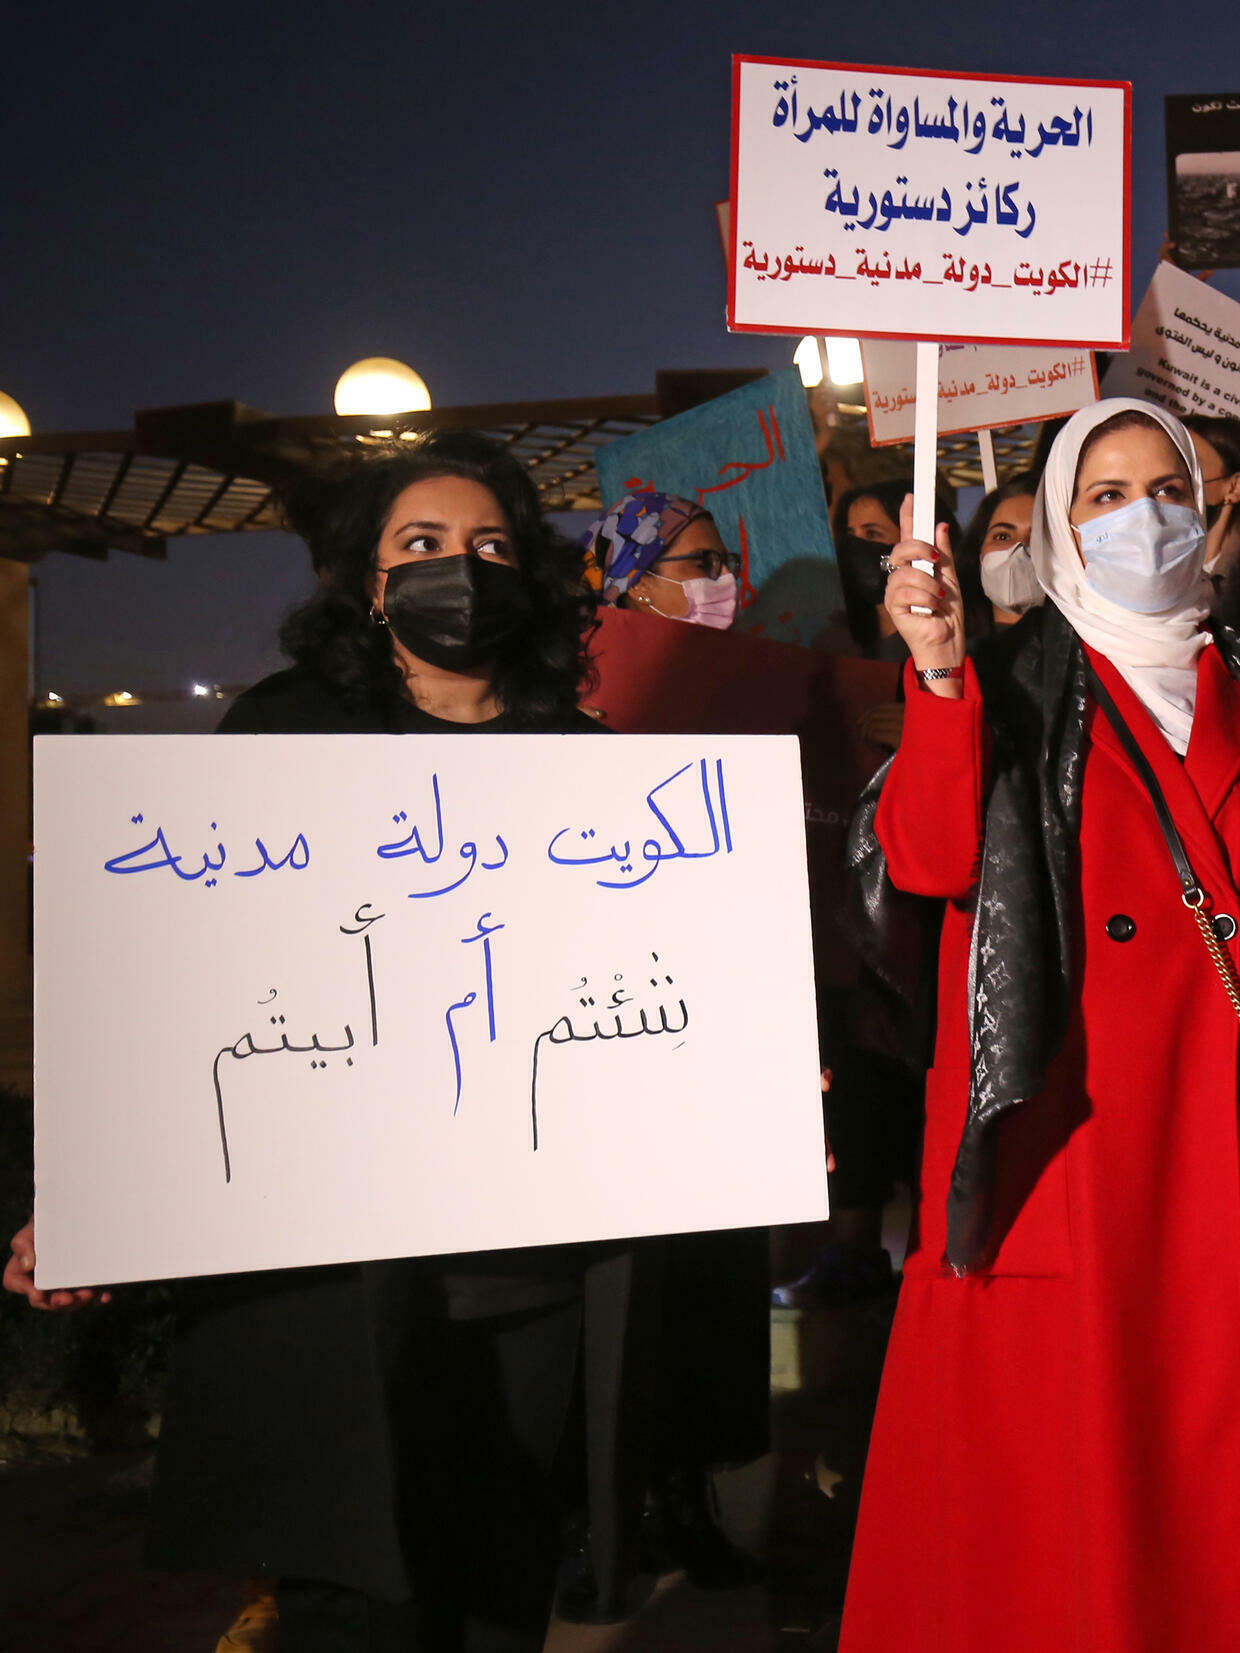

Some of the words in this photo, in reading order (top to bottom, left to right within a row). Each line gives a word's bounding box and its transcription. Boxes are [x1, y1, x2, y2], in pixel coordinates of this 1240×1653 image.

[772, 75, 861, 142] للمرأة
[868, 88, 986, 155] والمساواة
[992, 96, 1092, 158] الحرية
[823, 168, 951, 231] دستورية
[952, 177, 1036, 238] ركائز
[1136, 367, 1190, 397] governed
[1192, 392, 1206, 407] by
[1208, 402, 1216, 410] a
[1158, 358, 1199, 385] Kuwait
[1200, 379, 1211, 391] is
[1213, 387, 1222, 396] a
[103, 812, 311, 888] مدنية
[375, 773, 510, 898] دولة
[546, 758, 734, 889] الكويت
[445, 912, 505, 1117] أم
